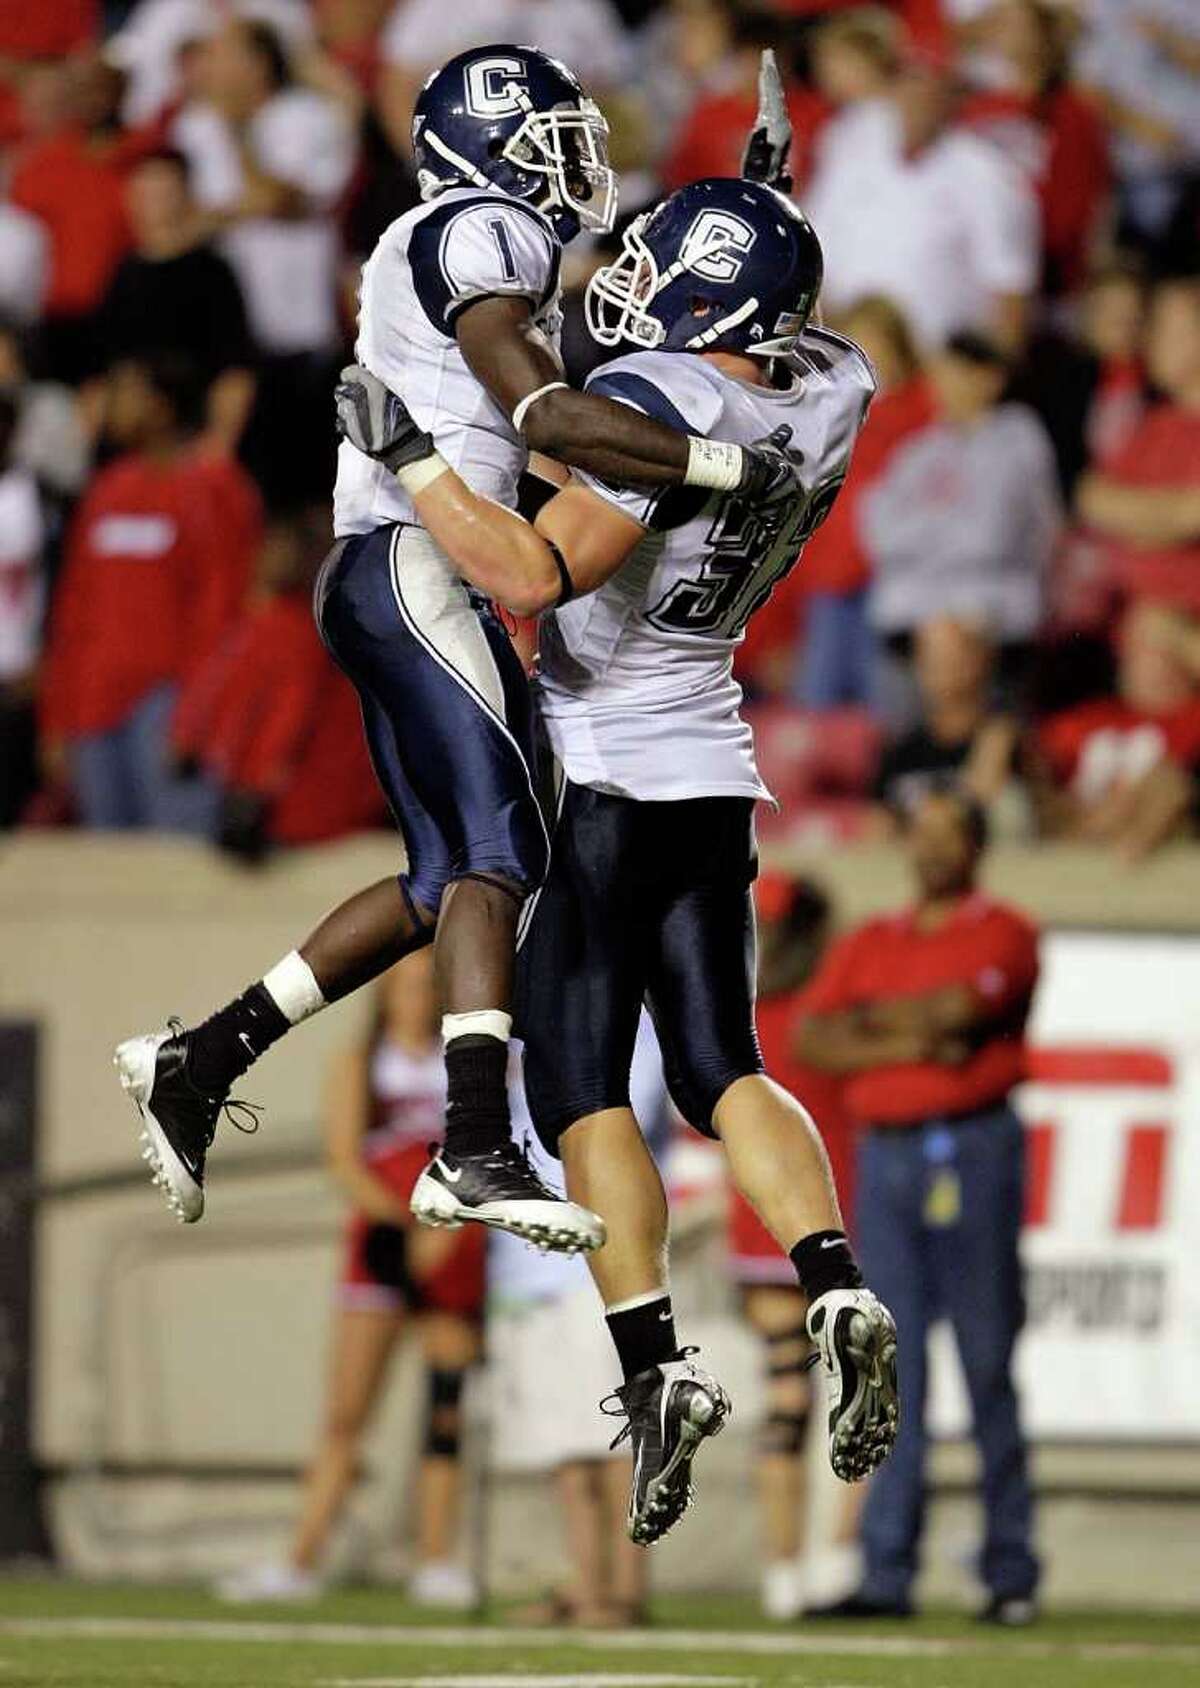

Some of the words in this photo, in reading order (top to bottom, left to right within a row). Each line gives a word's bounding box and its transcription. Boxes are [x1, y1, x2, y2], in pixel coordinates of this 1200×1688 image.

[463, 56, 529, 120] C
[487, 215, 520, 282] 1
[678, 208, 758, 283] C
